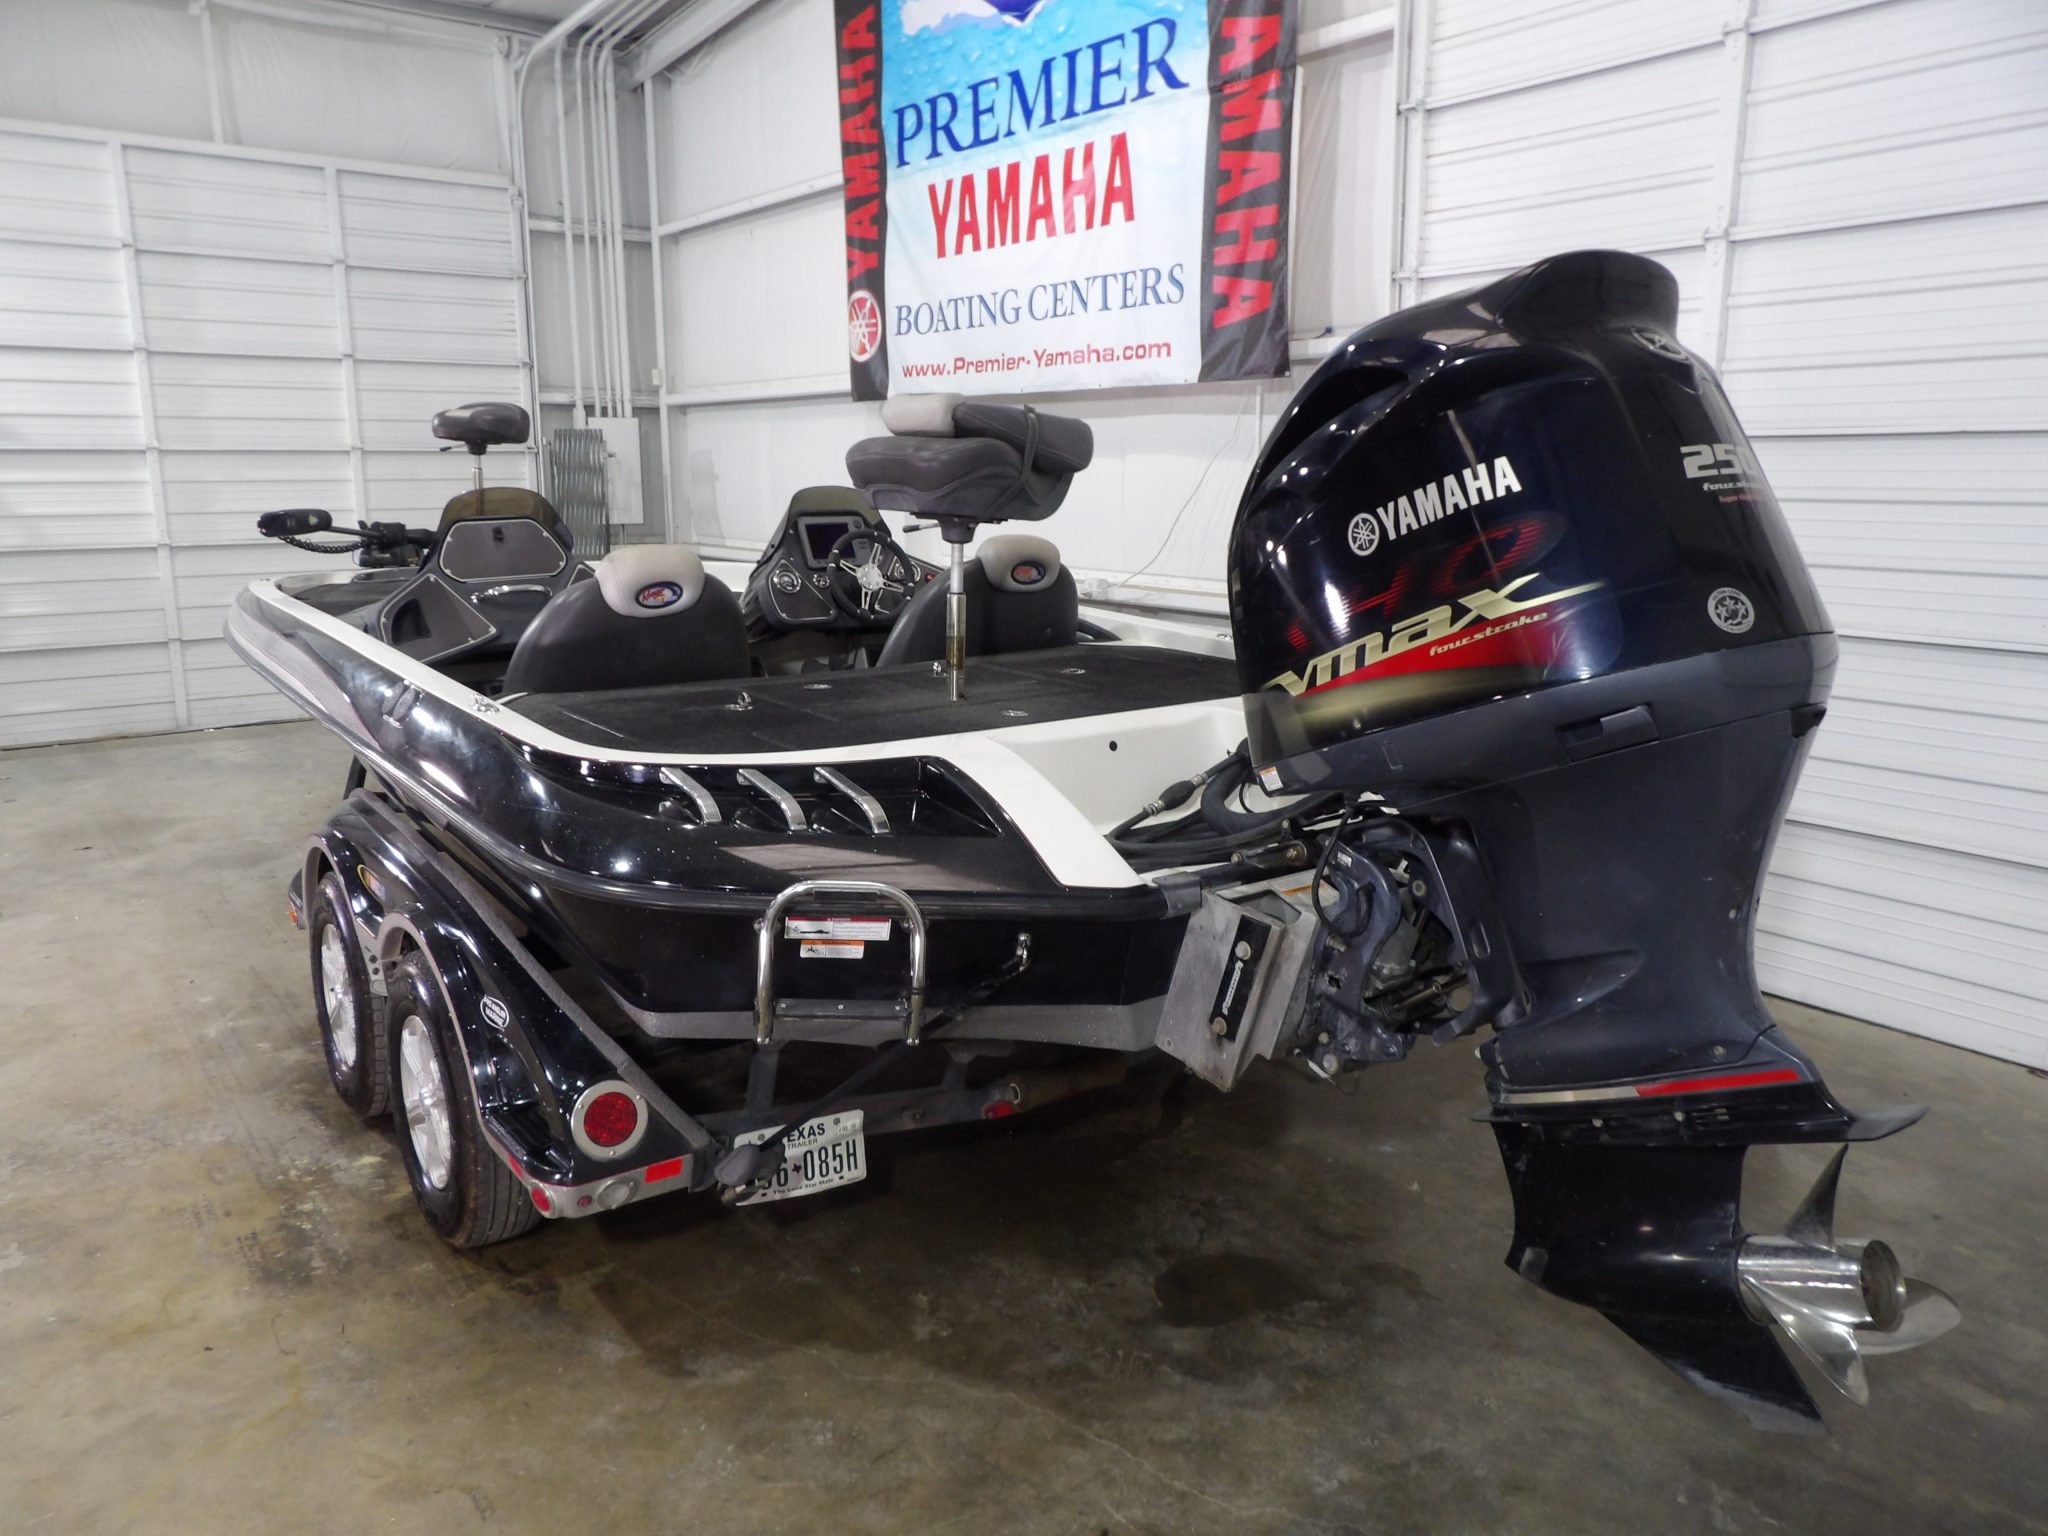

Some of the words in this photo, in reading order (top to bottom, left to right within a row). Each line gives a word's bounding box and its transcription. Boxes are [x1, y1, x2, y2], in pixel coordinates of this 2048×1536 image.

[892, 16, 1190, 168] PREMIER
[841, 2, 881, 282] YAMAHA
[1211, 0, 1283, 330] AMAHA
[927, 131, 1136, 260] YAMAHA
[894, 287, 1022, 337] BOATING
[1027, 263, 1185, 320] CENTERS
[901, 339, 1173, 379] www.Premier-Yamaha.com
[1376, 455, 1523, 542] YAMAHA
[786, 1122, 826, 1143] EXAS
[786, 1138, 818, 1150] TRAILER
